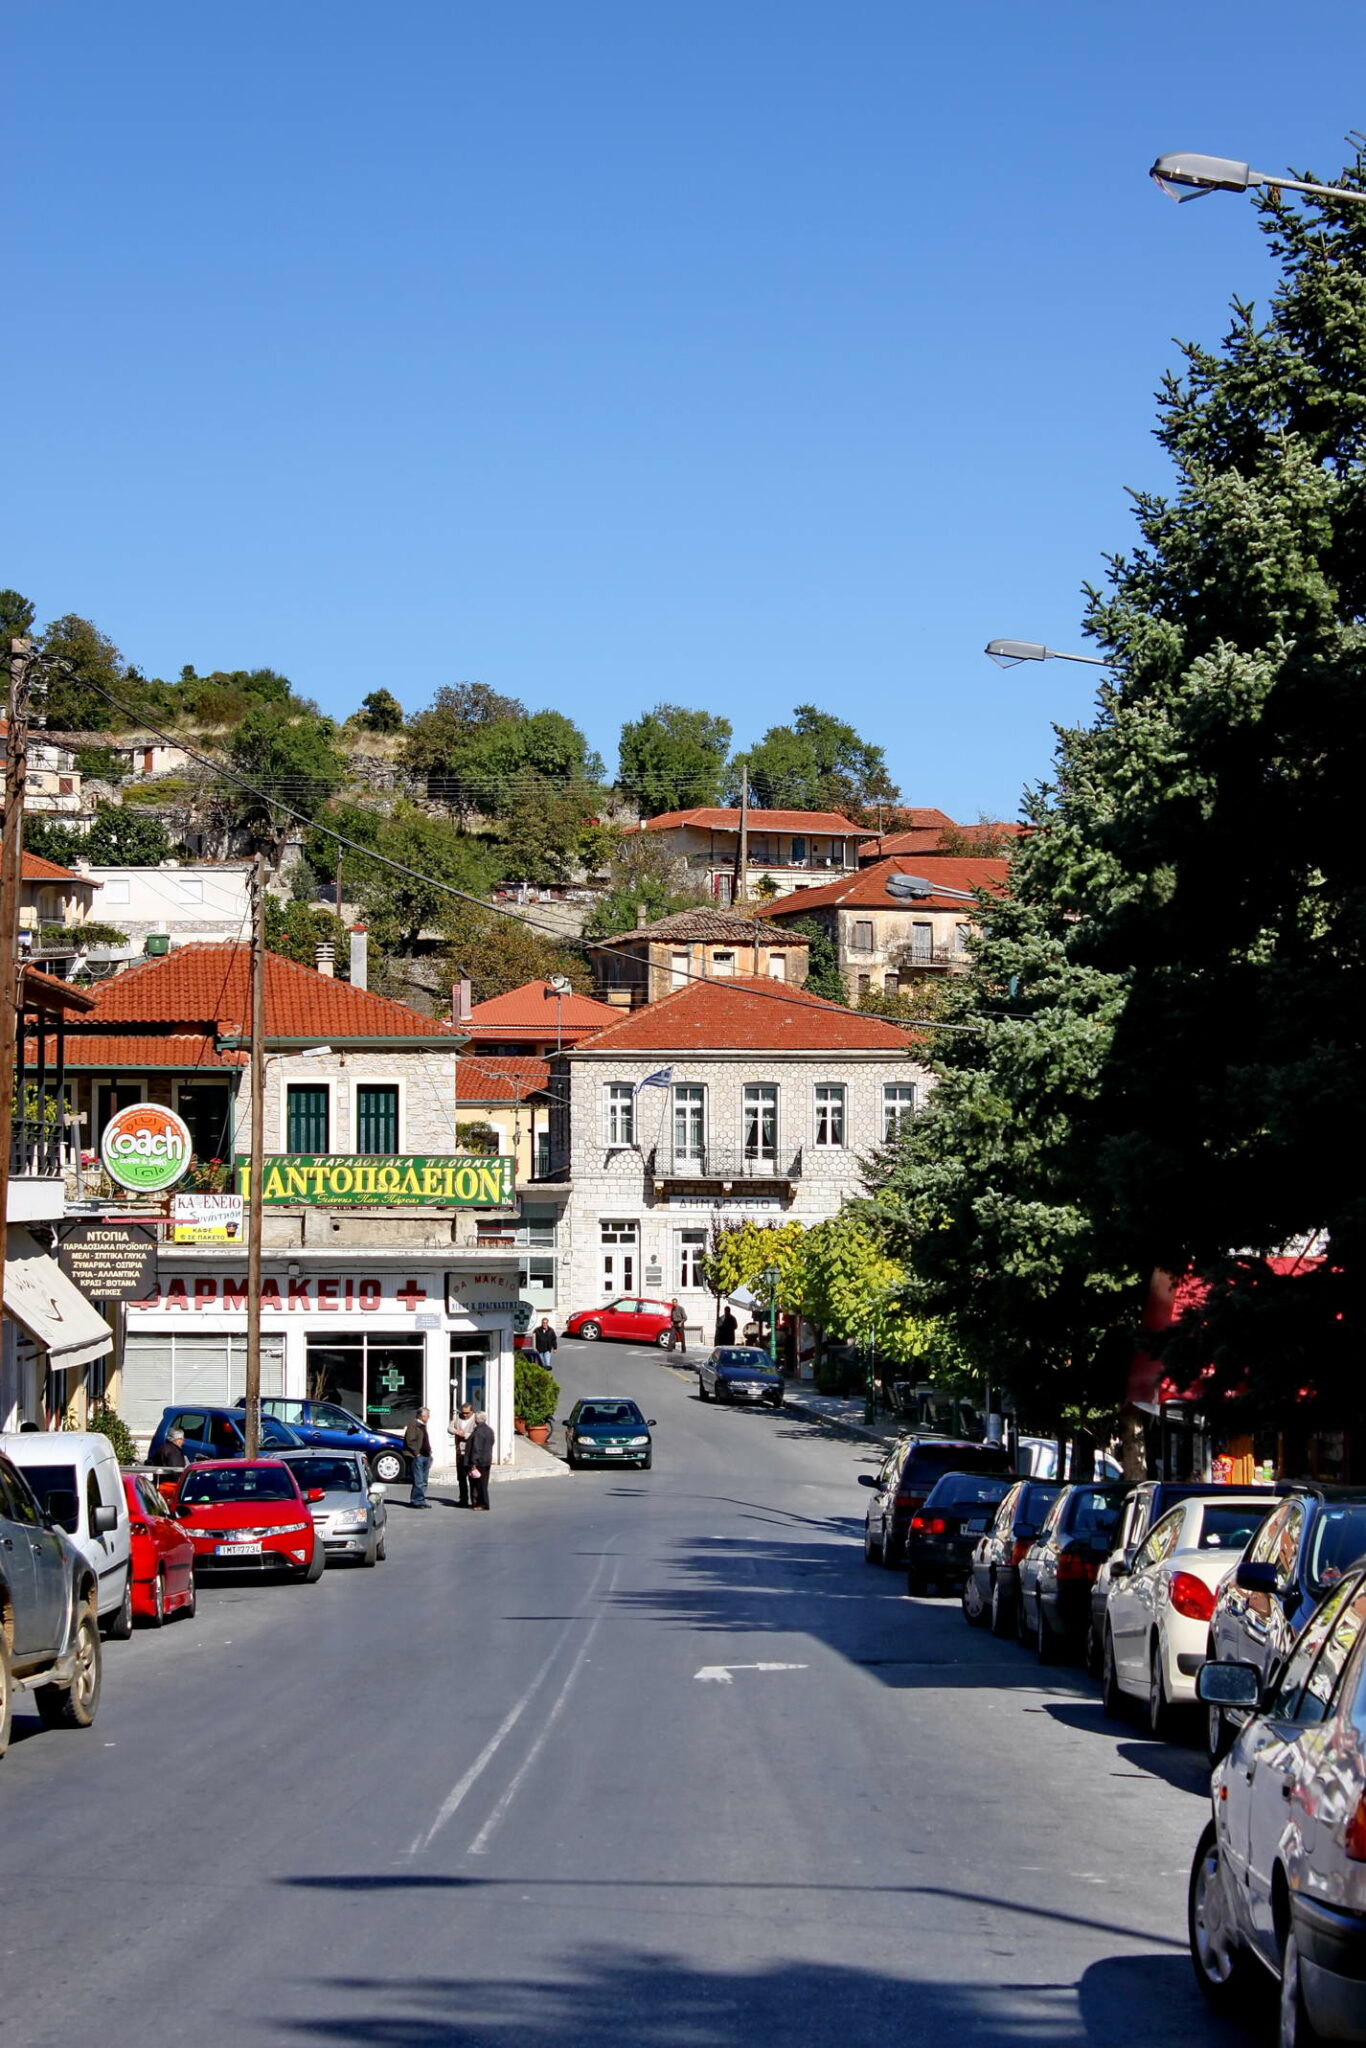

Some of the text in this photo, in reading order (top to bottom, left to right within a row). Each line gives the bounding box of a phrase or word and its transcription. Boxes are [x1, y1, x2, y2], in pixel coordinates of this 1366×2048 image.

[105, 1125, 183, 1160] Coach
[244, 1157, 301, 1166] ΤΠΙΚΑ
[312, 1157, 414, 1167] ΠΑΡΑΔΟΣΙΑΚΑ
[177, 1195, 241, 1209] ΚΑΕΝΕΙΟ
[679, 1197, 770, 1210] ΔΗΜΑΡΧΕΙΟ
[86, 1231, 130, 1241] ΝΤΟΠΙΑ
[72, 1270, 93, 1278] ΤΥΡΙΑ
[97, 1270, 140, 1278] ΑΛΛΑΝΤΙΚΑ
[90, 1288, 122, 1296] ΑΝΤΙΚΕΣ
